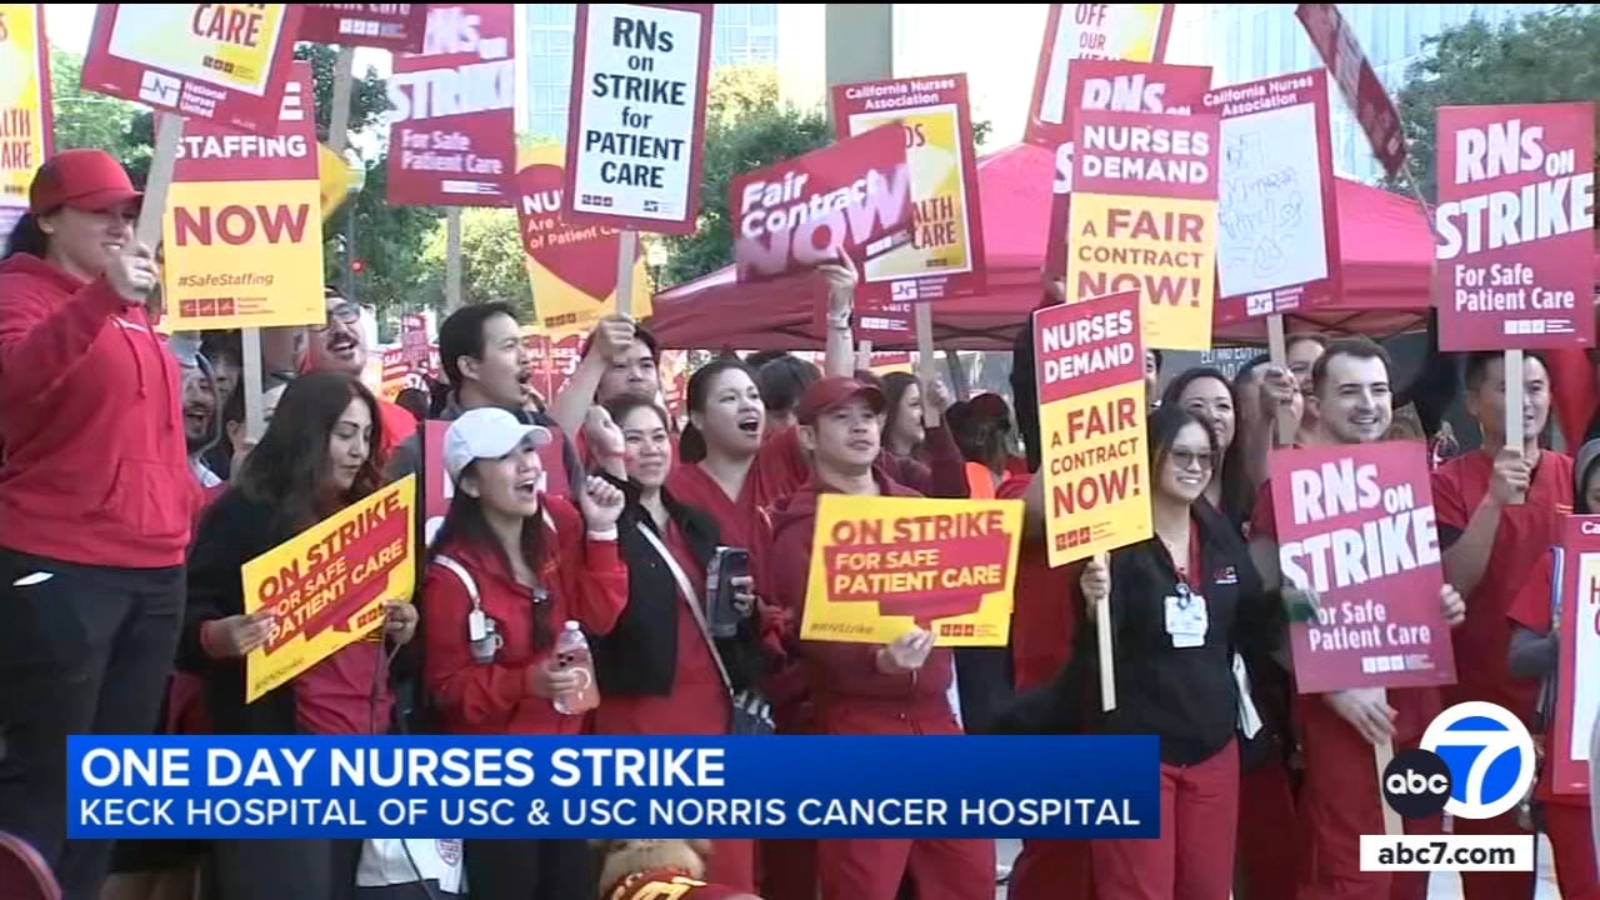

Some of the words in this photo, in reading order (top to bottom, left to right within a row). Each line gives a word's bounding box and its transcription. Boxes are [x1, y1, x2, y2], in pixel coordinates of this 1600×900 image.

[193, 4, 262, 47] CARE
[1075, 4, 1108, 27] OFF
[612, 16, 674, 53] RNs
[1079, 32, 1106, 50] OUR
[628, 55, 654, 72] on
[591, 73, 687, 106] STRIKE
[845, 82, 907, 100] California
[910, 78, 955, 93] Nurses
[864, 92, 940, 111] Association
[1203, 85, 1266, 107] California
[1268, 76, 1314, 95] Nurses
[621, 106, 653, 129] for
[1221, 93, 1298, 117] Association
[0, 108, 30, 137] LTH
[1, 141, 31, 168] ARE
[175, 135, 306, 158] STAFFING
[585, 130, 685, 161] PATIENT
[1083, 125, 1210, 156] NURSES
[1455, 119, 1544, 184] RNs
[1545, 149, 1575, 177] ON
[400, 149, 462, 172] Patient
[465, 155, 504, 174] Care
[600, 161, 664, 188] CARE
[1082, 156, 1209, 184] DEMAND
[740, 178, 868, 238] Contrac
[741, 171, 809, 214] Fair
[173, 204, 309, 246] NOW
[735, 164, 910, 276] NOW
[911, 196, 953, 224] ALTH
[1081, 221, 1097, 238] A
[1106, 208, 1205, 243] FAIR
[1435, 172, 1594, 260] STRIKE
[527, 219, 554, 233] Are
[530, 235, 545, 249] of
[548, 226, 597, 246] Patient
[1078, 245, 1204, 269] CONTRACT
[178, 273, 274, 287] #SafeStaffing
[1077, 270, 1200, 308] NOW!
[1455, 265, 1488, 287] For
[1491, 263, 1534, 285] Safe
[1455, 289, 1527, 311] Patient
[1531, 287, 1575, 309] Care
[1042, 309, 1132, 353] NURSES
[1043, 343, 1135, 384] DEMAND
[1051, 430, 1062, 450] A
[1067, 398, 1137, 444] FAIR
[1050, 437, 1139, 476] CONTRACT
[1052, 464, 1140, 519] NOW!
[1290, 457, 1381, 525] RNs
[1383, 483, 1413, 514] ON
[831, 520, 882, 545] ON
[893, 510, 1005, 541] STRIKE
[258, 559, 300, 603] ON
[306, 489, 401, 573] STRIKE
[836, 553, 880, 571] FOR
[885, 549, 940, 568] SAFE
[1280, 505, 1440, 593] STRIKE
[268, 578, 348, 645] PATIENT
[351, 538, 404, 585] CARE
[305, 556, 347, 597] SAFE
[834, 571, 936, 594] PATIENT
[942, 564, 1001, 590] CARE
[1318, 603, 1337, 627] or
[1341, 599, 1386, 624] Safe
[1308, 625, 1382, 652] Patient
[1386, 623, 1430, 646] Care
